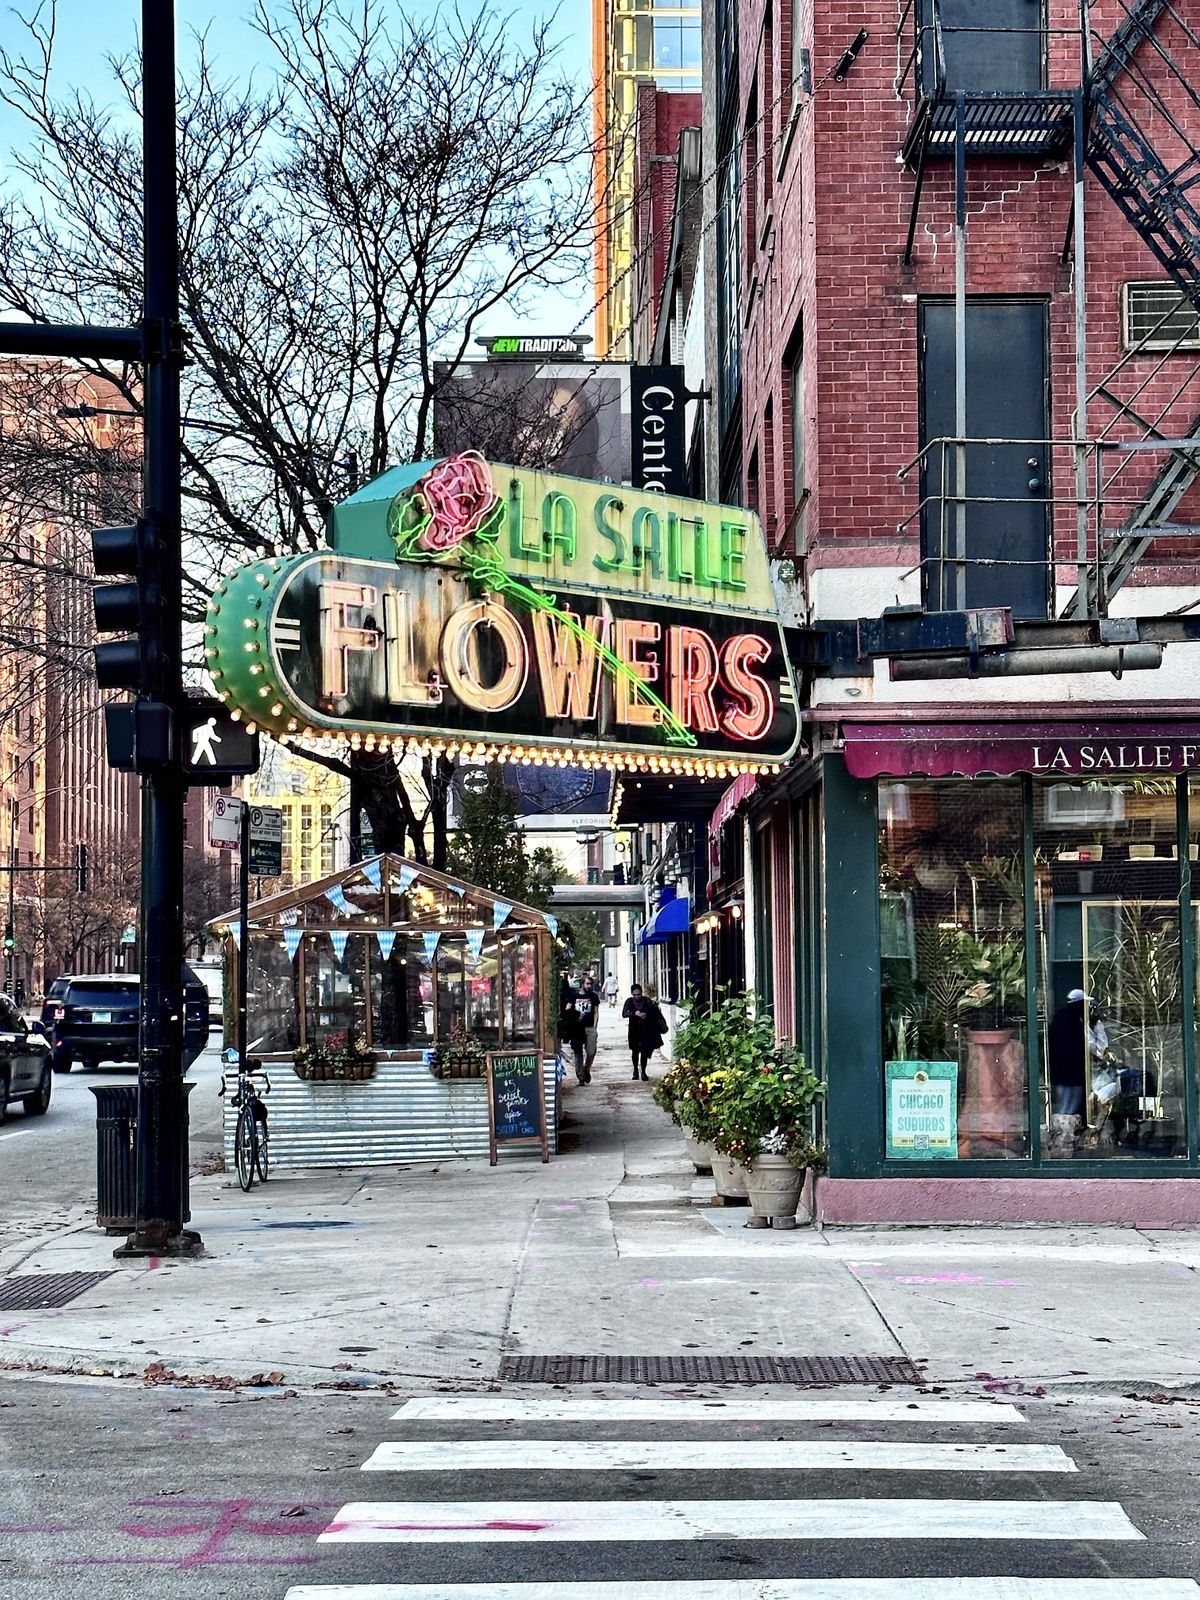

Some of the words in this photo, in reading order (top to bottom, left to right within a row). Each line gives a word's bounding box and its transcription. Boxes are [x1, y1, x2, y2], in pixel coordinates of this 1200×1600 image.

[509, 478, 578, 566] LA
[592, 494, 749, 593] SALLE
[318, 581, 775, 741] FLOWERS
[1032, 746, 1072, 768] LA
[1079, 746, 1173, 769] SALLE
[1181, 745, 1200, 768] F
[899, 1094, 944, 1109] CHICAGO
[897, 1116, 945, 1132] SUBURBS
